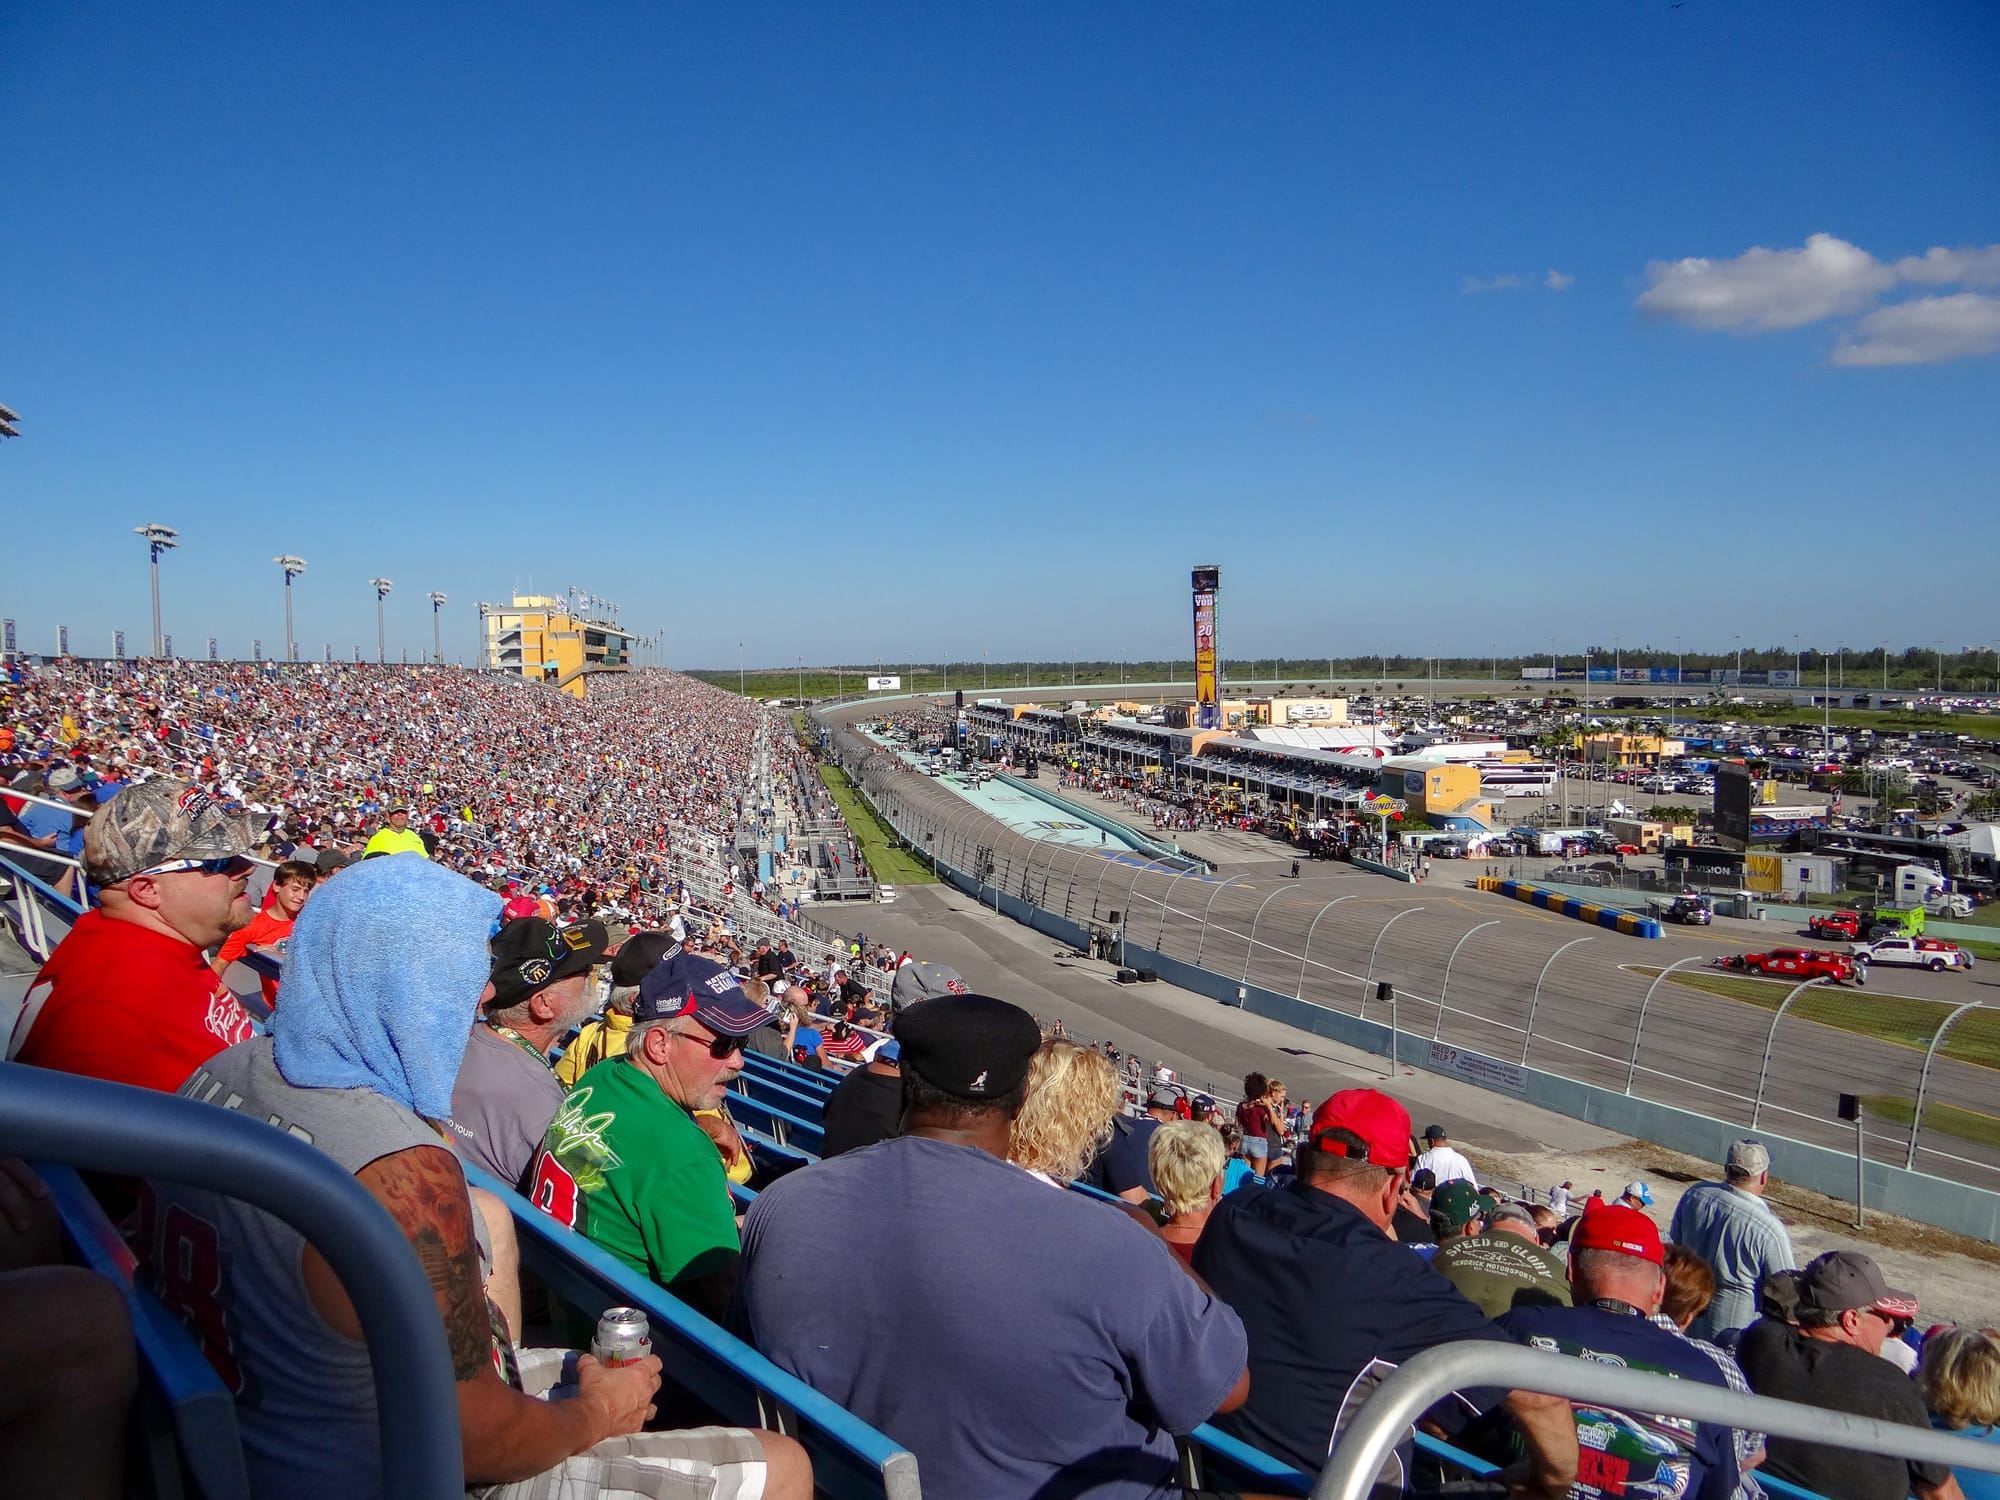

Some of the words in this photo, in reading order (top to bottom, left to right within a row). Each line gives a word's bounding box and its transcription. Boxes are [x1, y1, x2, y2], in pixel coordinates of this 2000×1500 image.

[1199, 625, 1212, 636] 20
[1620, 670, 1646, 679] FedEx
[1366, 801, 1404, 810] SUNOCO
[1431, 1043, 1450, 1055] NEED
[1430, 1050, 1449, 1062] HELP
[454, 1122, 474, 1139] YOUR
[1445, 1238, 1491, 1257] SPEED
[1493, 1240, 1509, 1248] AND
[1510, 1244, 1553, 1279] GLORY
[1452, 1259, 1484, 1269] HENDRICK
[1486, 1262, 1538, 1284] MOTORSPORTS
